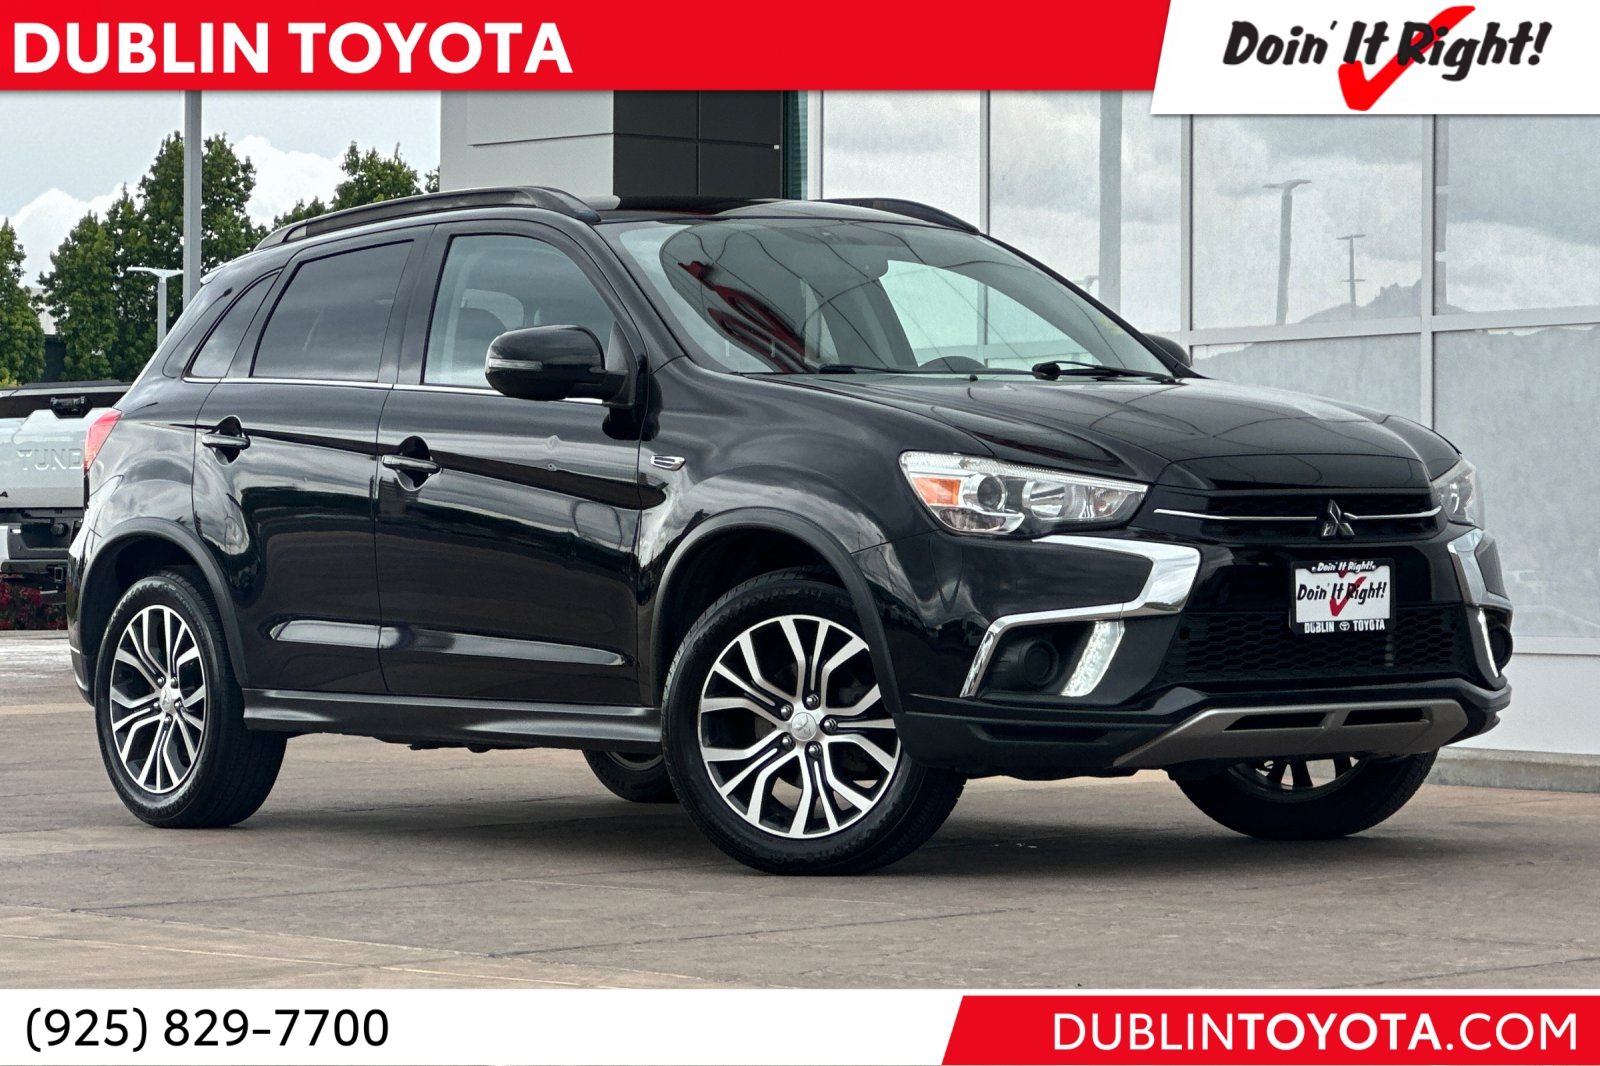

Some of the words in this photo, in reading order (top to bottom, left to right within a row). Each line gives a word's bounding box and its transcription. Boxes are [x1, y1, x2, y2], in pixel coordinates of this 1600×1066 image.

[1338, 562, 1347, 571] It
[1297, 583, 1330, 601] Doin'
[1331, 582, 1344, 600] It
[1346, 581, 1387, 605] Right!
[1304, 622, 1335, 634] DUBLIN
[1353, 619, 1385, 632] TOYOTA
